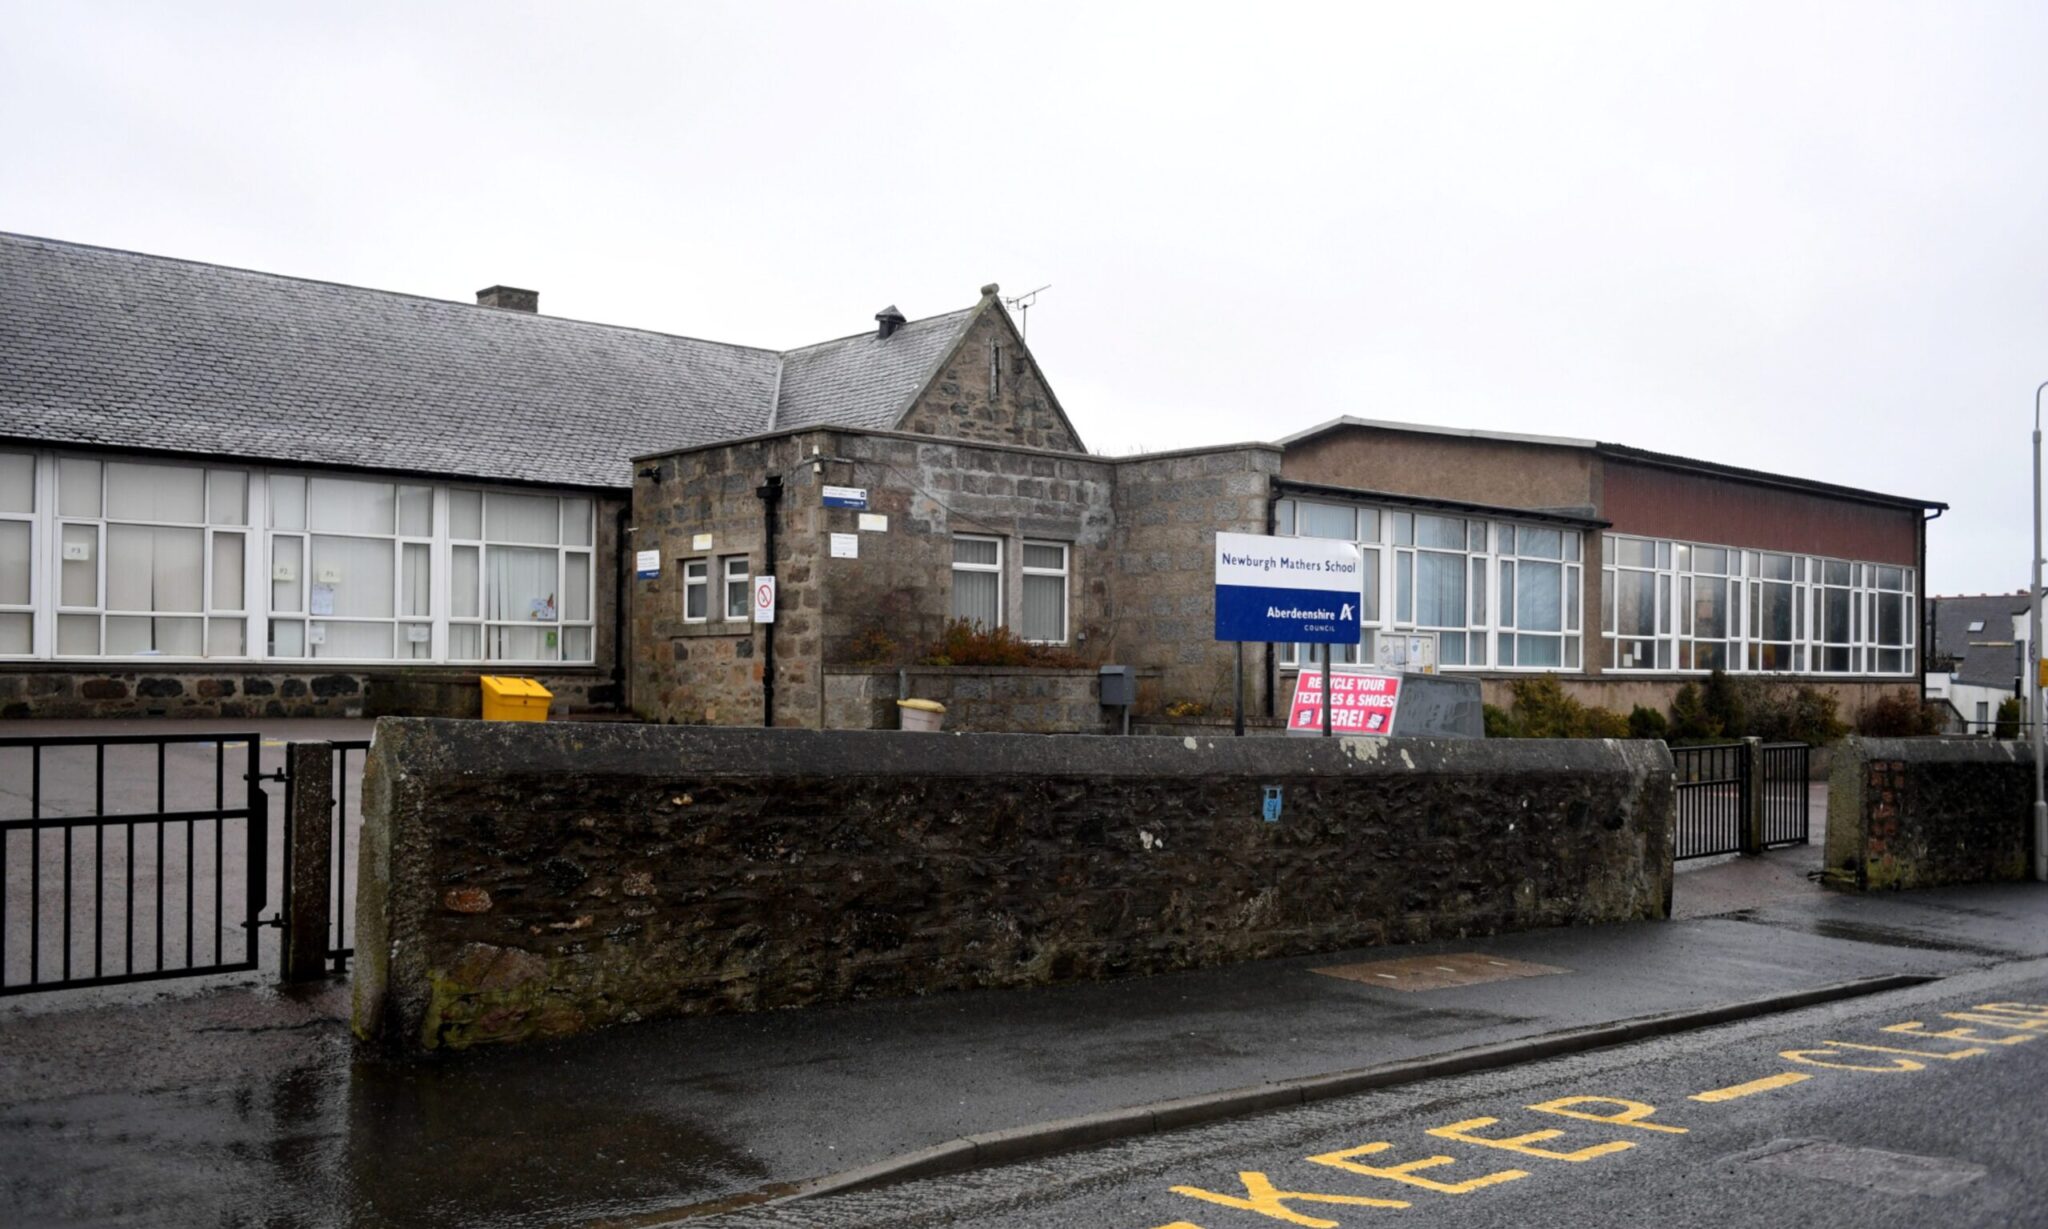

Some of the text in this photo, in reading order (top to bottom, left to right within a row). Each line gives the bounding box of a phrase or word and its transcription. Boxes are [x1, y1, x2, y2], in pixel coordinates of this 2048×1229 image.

[1222, 553, 1356, 573] Newburgh Mathers School
[1267, 606, 1335, 620] Aberdeenshire
[1304, 624, 1335, 632] COUNCIL
[1307, 677, 1386, 691] REYCLE YOUR
[1298, 692, 1395, 707] TEXTES & SHOES
[1169, 1096, 1689, 1229] KEEP
